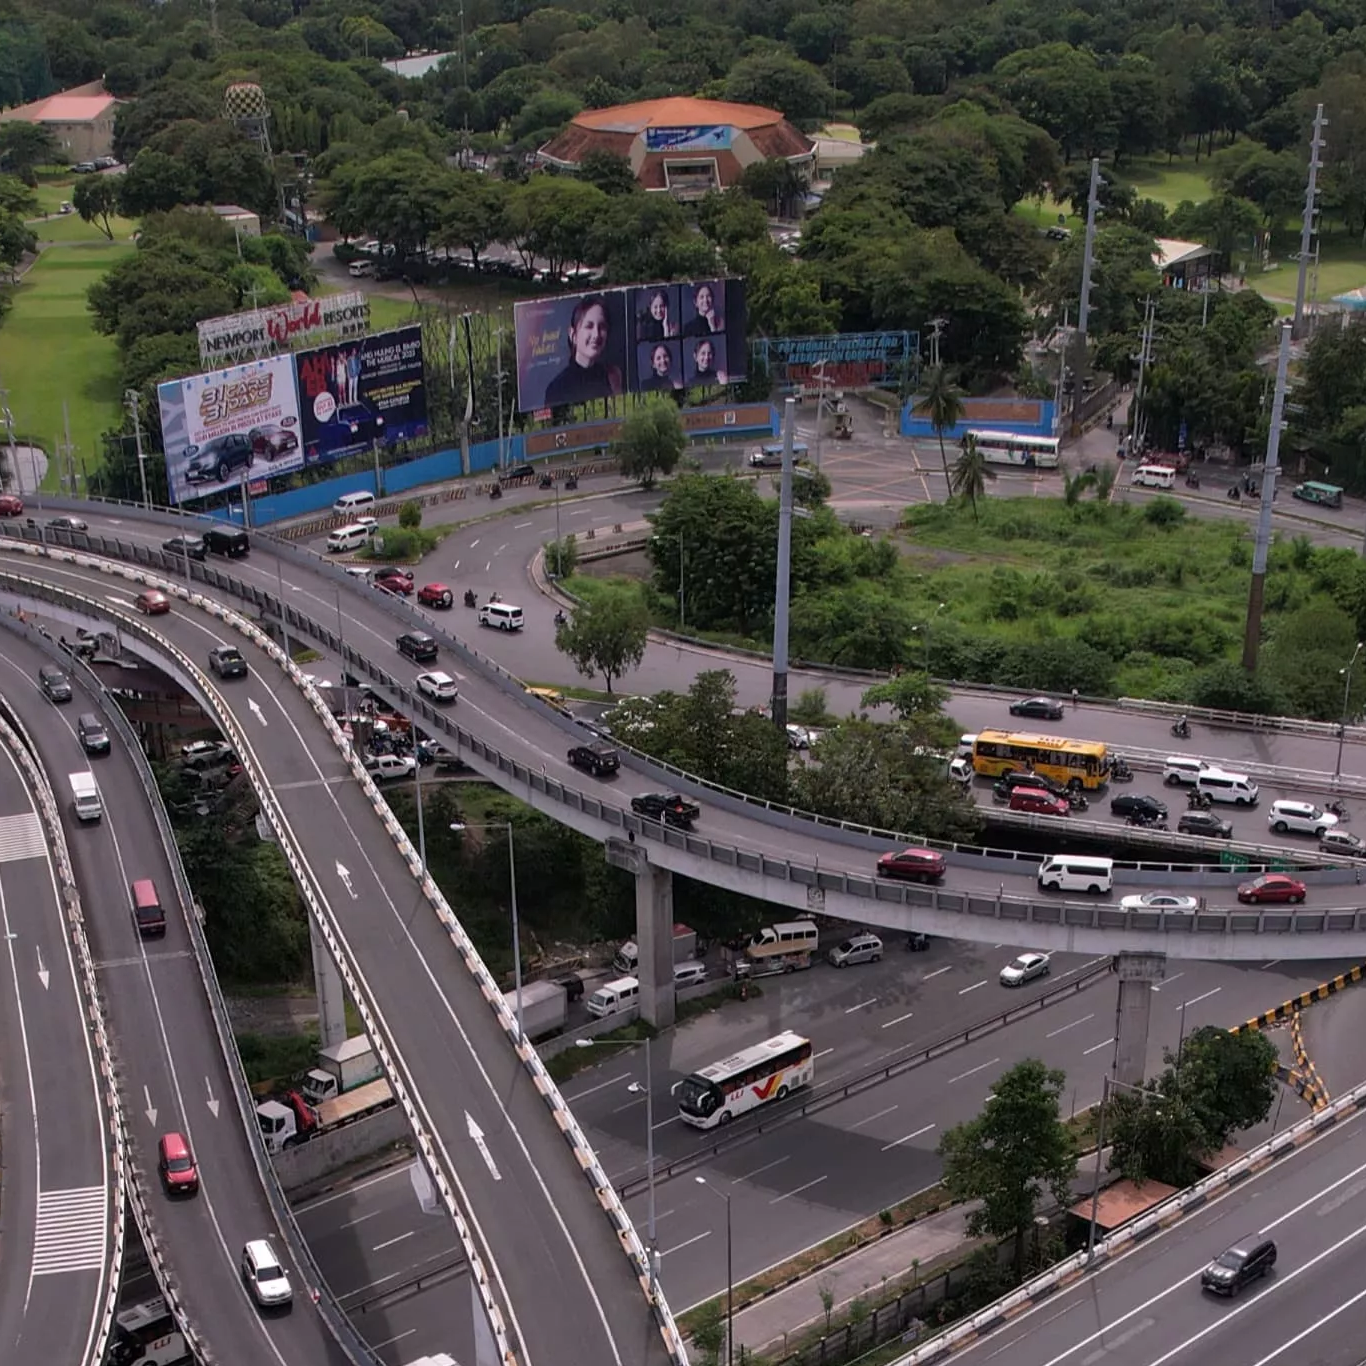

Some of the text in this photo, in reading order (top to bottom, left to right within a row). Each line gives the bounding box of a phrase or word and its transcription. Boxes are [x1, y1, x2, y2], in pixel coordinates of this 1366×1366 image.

[206, 327, 265, 353] NEWPORT
[266, 301, 321, 344] World
[323, 303, 371, 325] RESORTS
[202, 378, 269, 405] 31 CARS
[205, 400, 228, 421] 31
[229, 387, 269, 409] DAYS
